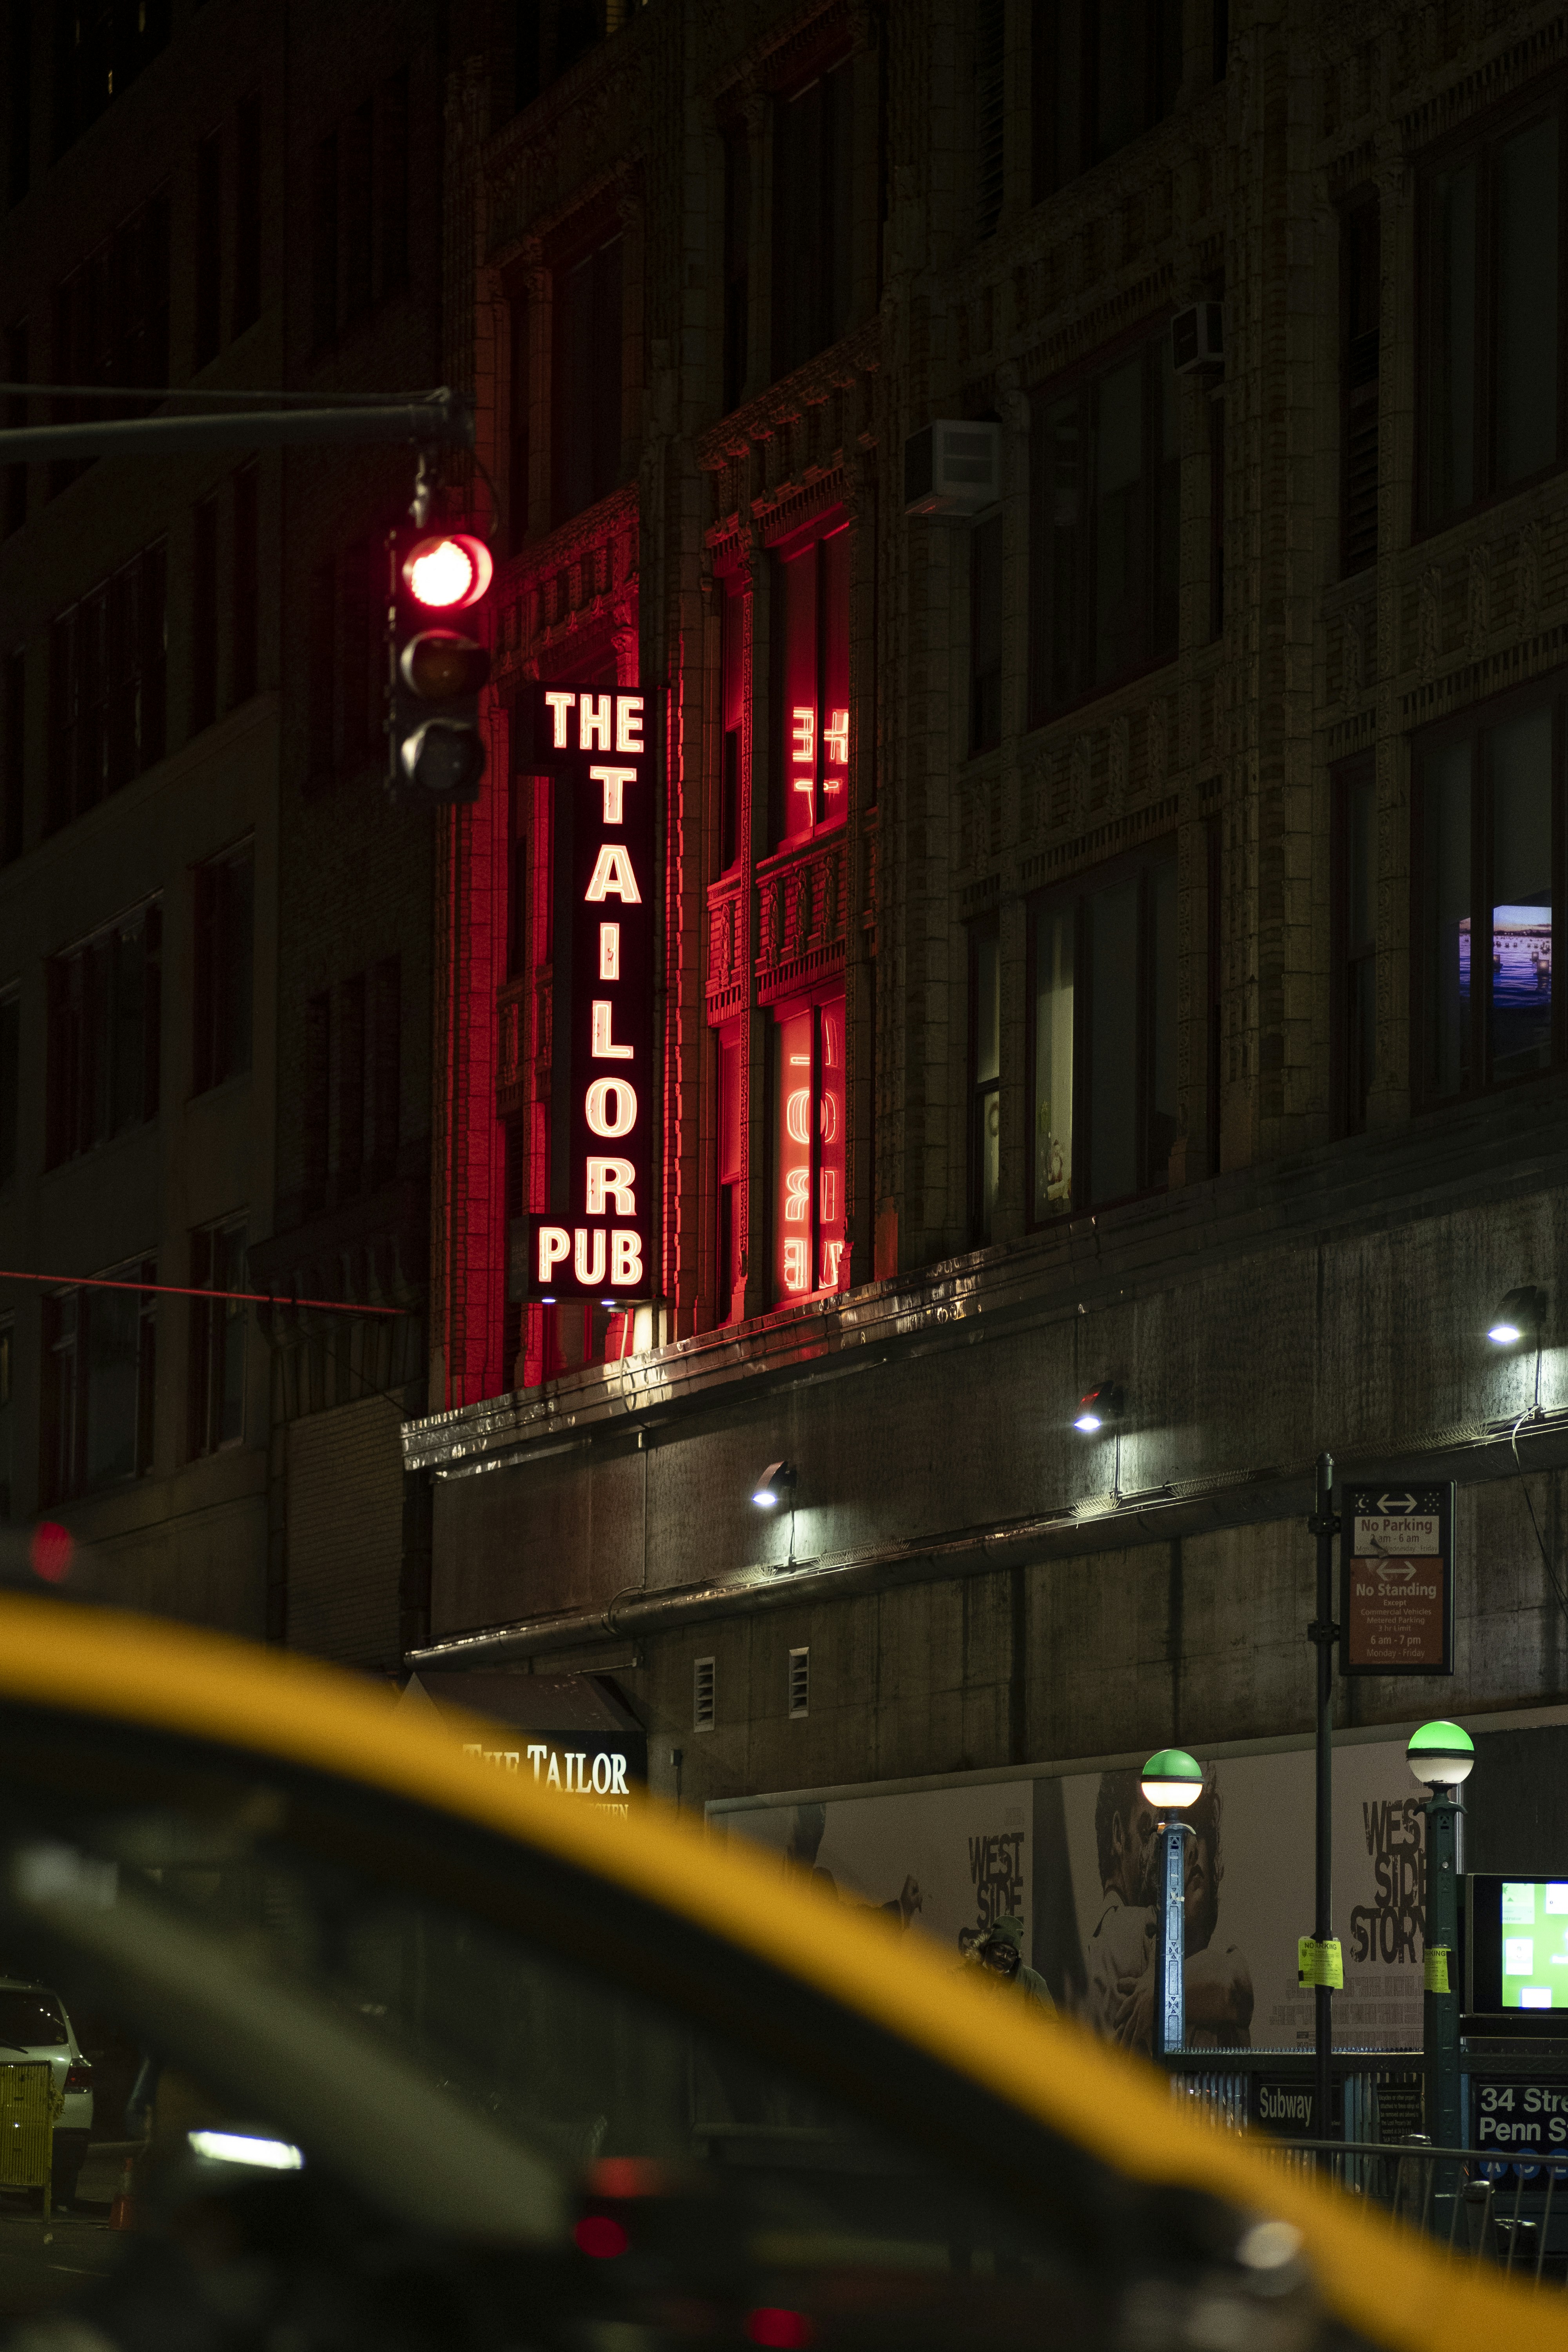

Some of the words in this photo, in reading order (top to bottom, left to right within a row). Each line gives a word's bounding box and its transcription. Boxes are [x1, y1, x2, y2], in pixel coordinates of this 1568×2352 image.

[546, 692, 644, 752] THE
[584, 766, 642, 1216] TAILOR
[539, 1227, 642, 1285] PUB
[1361, 1519, 1379, 1531] No
[1383, 1518, 1432, 1534] Parking
[1399, 1534, 1404, 1542] 6
[1356, 1584, 1374, 1596] No
[1378, 1583, 1436, 1599] Standing
[1371, 1635, 1376, 1644] 6
[1399, 1635, 1405, 1644] 7
[1407, 1637, 1421, 1646] pm
[1367, 1649, 1396, 1658] Monday
[1403, 1648, 1425, 1658] Friday
[969, 1832, 1024, 1884] WEST
[1260, 2087, 1312, 2127] Subway
[1481, 2088, 1515, 2111] 34
[1480, 2117, 1541, 2141] Penn
[1548, 2117, 1568, 2142] S
